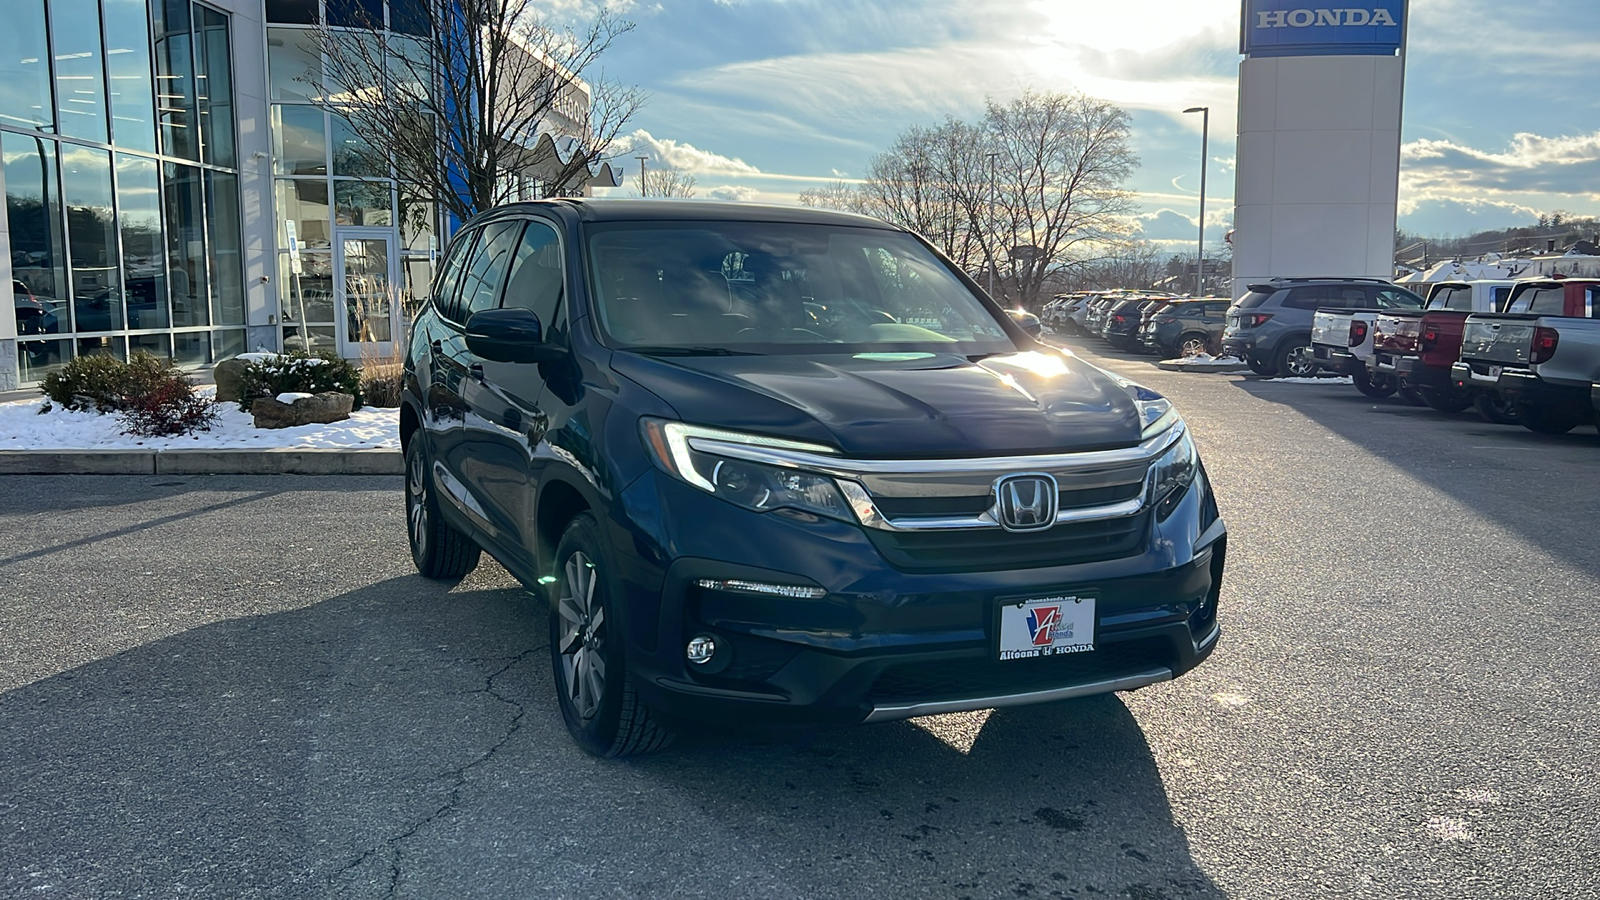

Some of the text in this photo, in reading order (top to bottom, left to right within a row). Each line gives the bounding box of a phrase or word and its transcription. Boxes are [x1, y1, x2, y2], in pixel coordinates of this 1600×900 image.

[1256, 8, 1397, 28] HONDA
[999, 650, 1039, 660] Altoona
[1055, 644, 1094, 654] HONDA
